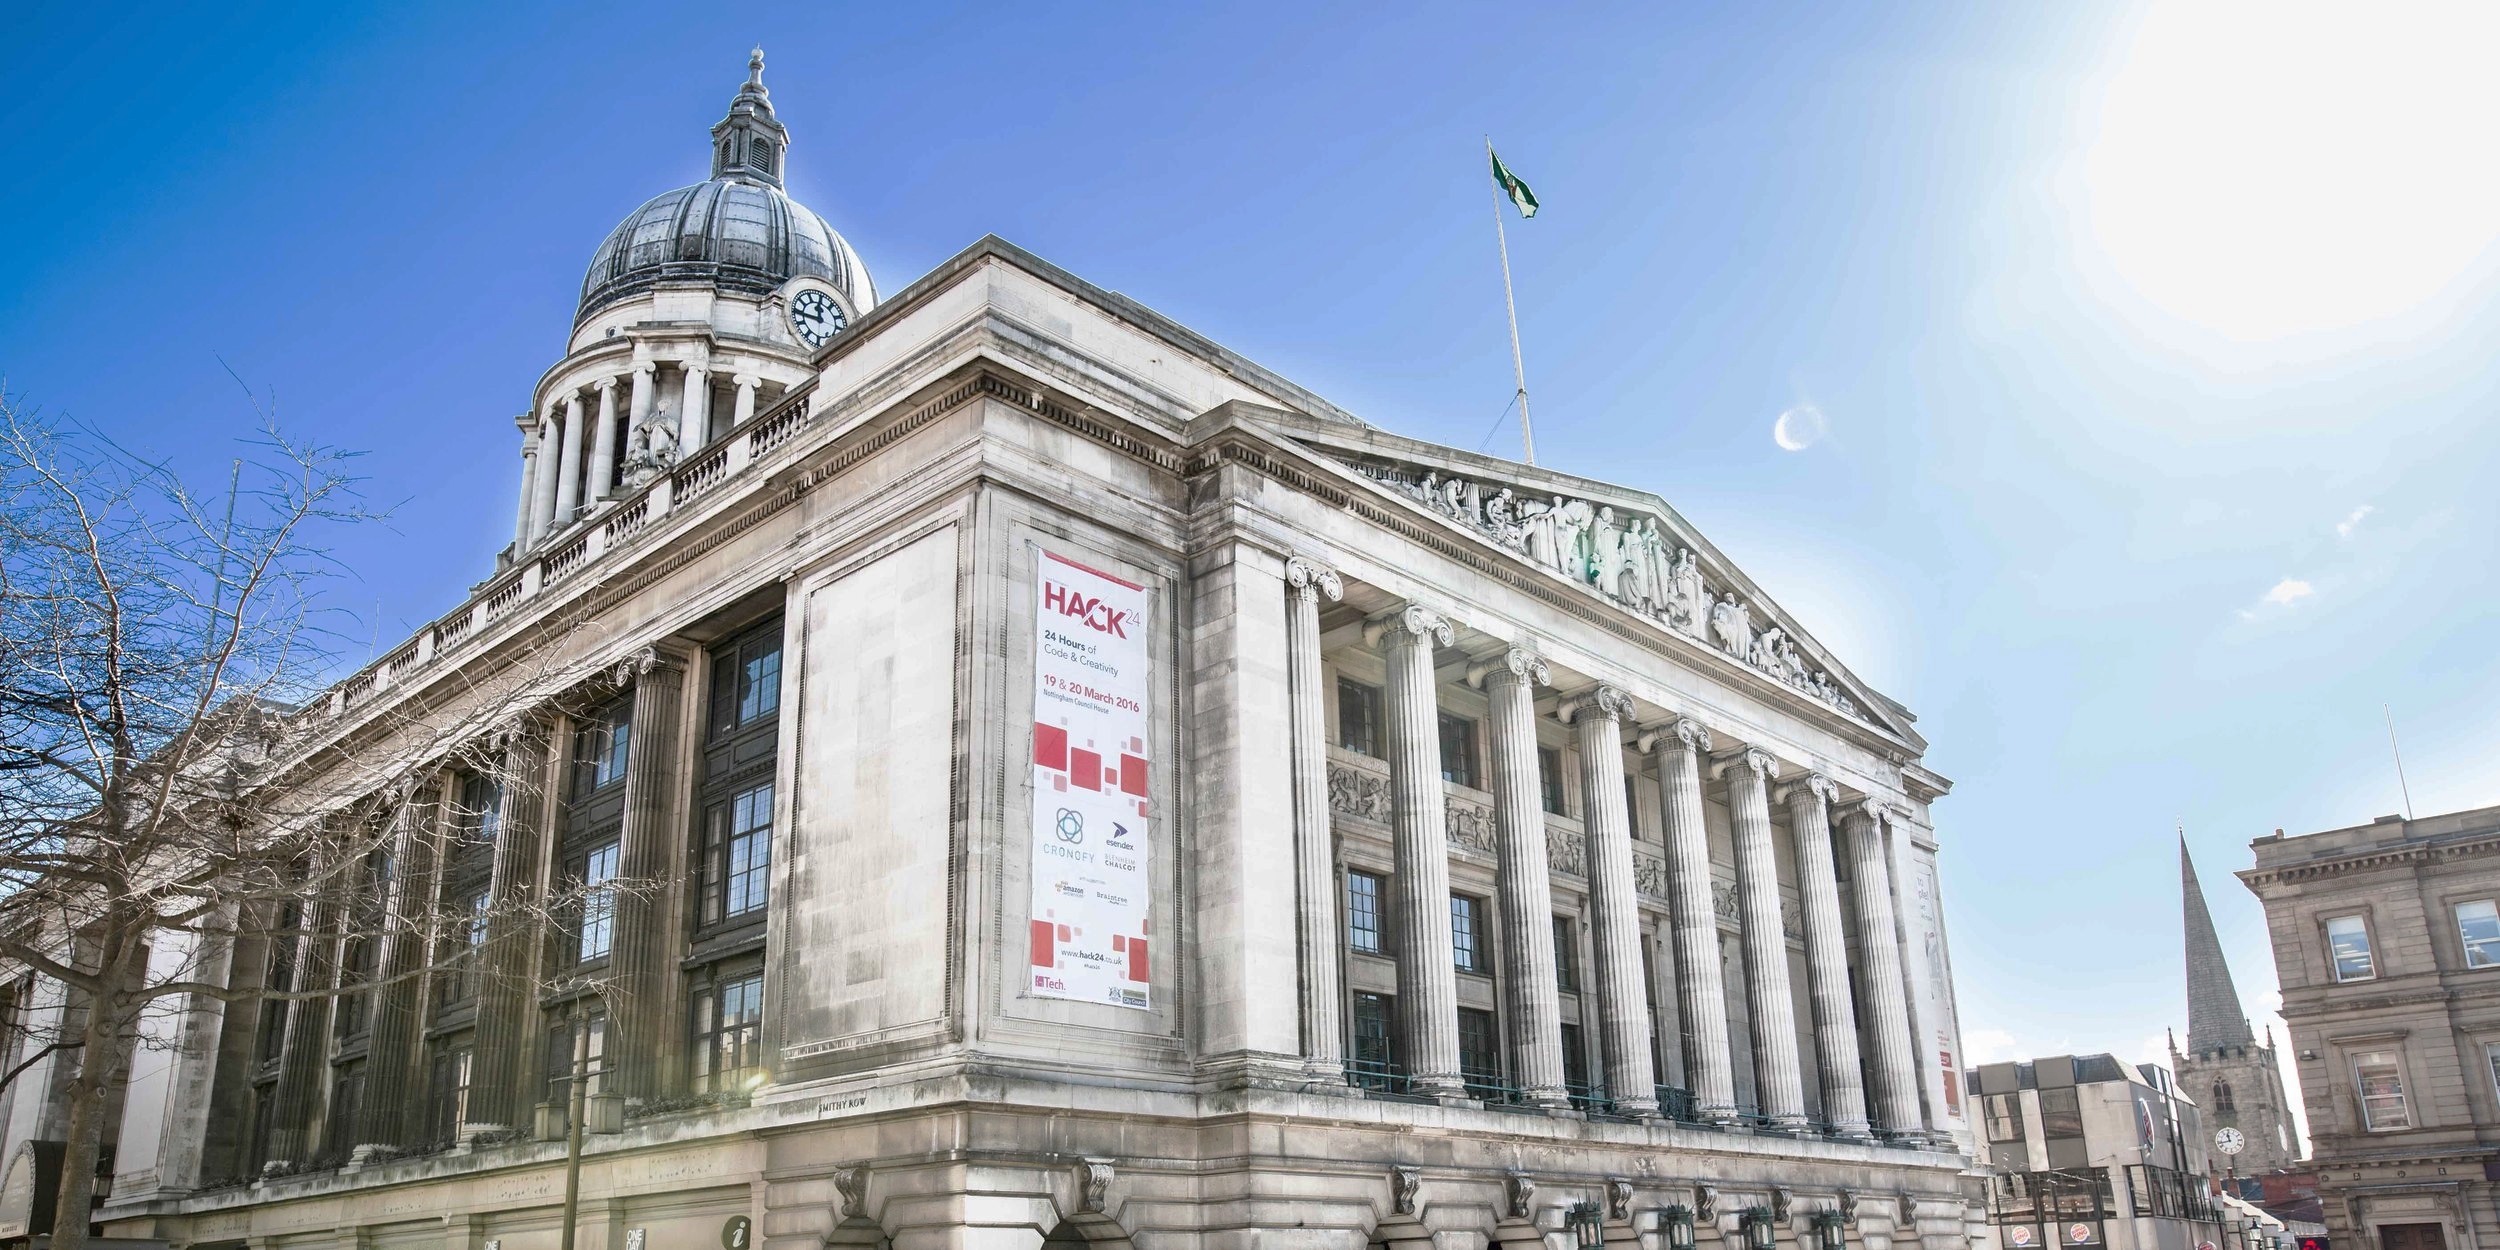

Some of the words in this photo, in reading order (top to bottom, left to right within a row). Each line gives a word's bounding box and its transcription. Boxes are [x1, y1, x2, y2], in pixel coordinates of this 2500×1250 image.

[1045, 581, 1127, 640] HACK
[1044, 629, 1056, 642] 24
[1058, 633, 1086, 651] Hours
[1087, 645, 1097, 654] of
[1044, 644, 1069, 660] Code
[1070, 652, 1078, 662] &
[1079, 655, 1119, 677] Creativity
[1043, 674, 1057, 687] 19
[1059, 679, 1067, 691] &
[1069, 682, 1082, 695] 20
[1084, 686, 1114, 706] March
[1116, 697, 1140, 713] 2016
[1043, 688, 1074, 703] Nottingham
[1074, 697, 1093, 709] Council
[1093, 703, 1110, 714] House
[1043, 842, 1095, 864] CRONOFY
[1106, 839, 1135, 851] esendex
[1104, 860, 1136, 872] CHALCOT
[1063, 885, 1084, 895] amazon
[1096, 891, 1128, 903] Braintree
[1060, 949, 1122, 965] www.hack24.co.uk
[818, 1100, 847, 1113] SMITHY
[848, 1097, 867, 1108] ROW
[627, 1229, 643, 1242] ONE
[484, 1240, 498, 1250] ONE
[626, 1239, 641, 1250] DAY
